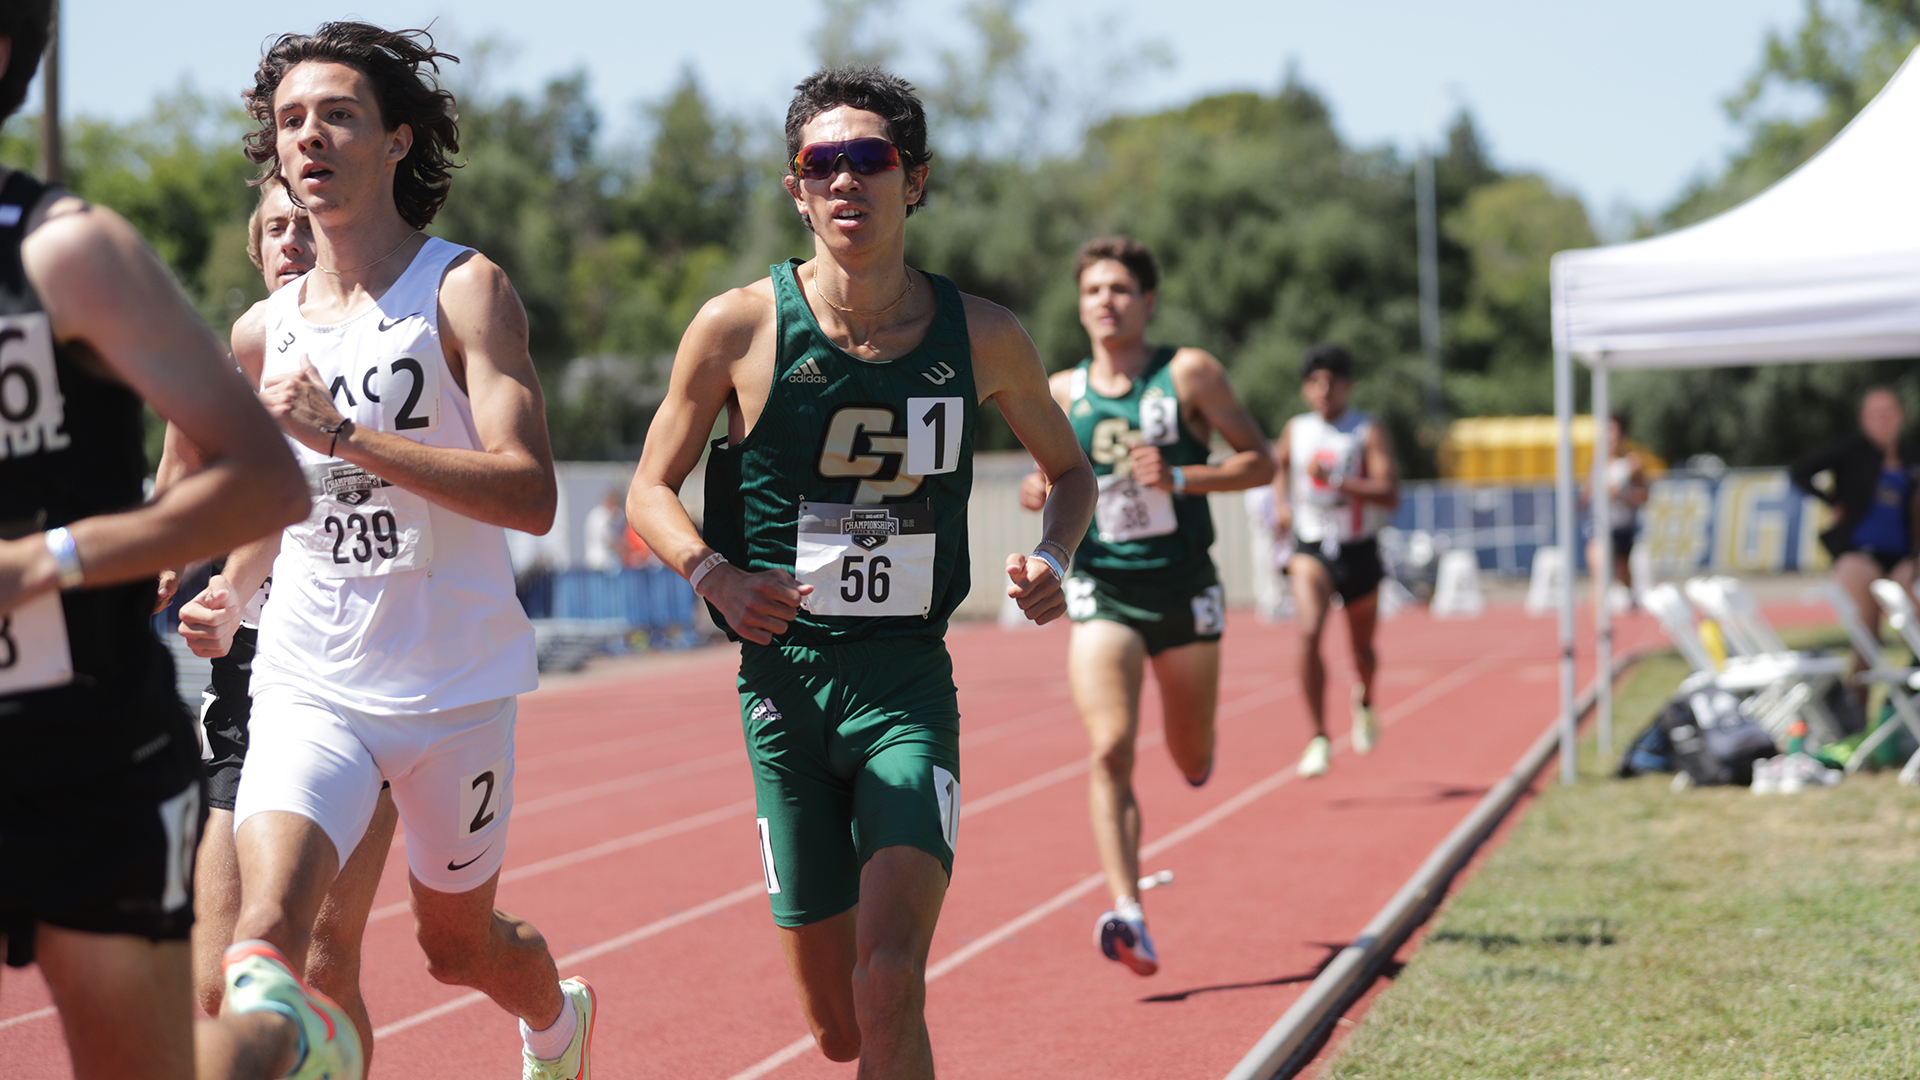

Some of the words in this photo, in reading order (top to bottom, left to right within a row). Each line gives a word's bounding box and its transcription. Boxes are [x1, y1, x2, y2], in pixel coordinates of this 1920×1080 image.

[0, 327, 39, 423] 6
[390, 357, 430, 431] 2
[788, 373, 828, 384] adidas
[922, 402, 946, 470] 1
[1151, 401, 1168, 440] 3
[326, 474, 378, 492] CHAMPIONSHIPS
[324, 509, 399, 564] 239
[845, 521, 895, 533] CHAMPIONSHIPS
[840, 555, 892, 604] 56
[751, 711, 783, 721] adidas
[469, 770, 495, 834] 2
[945, 778, 955, 844] 1
